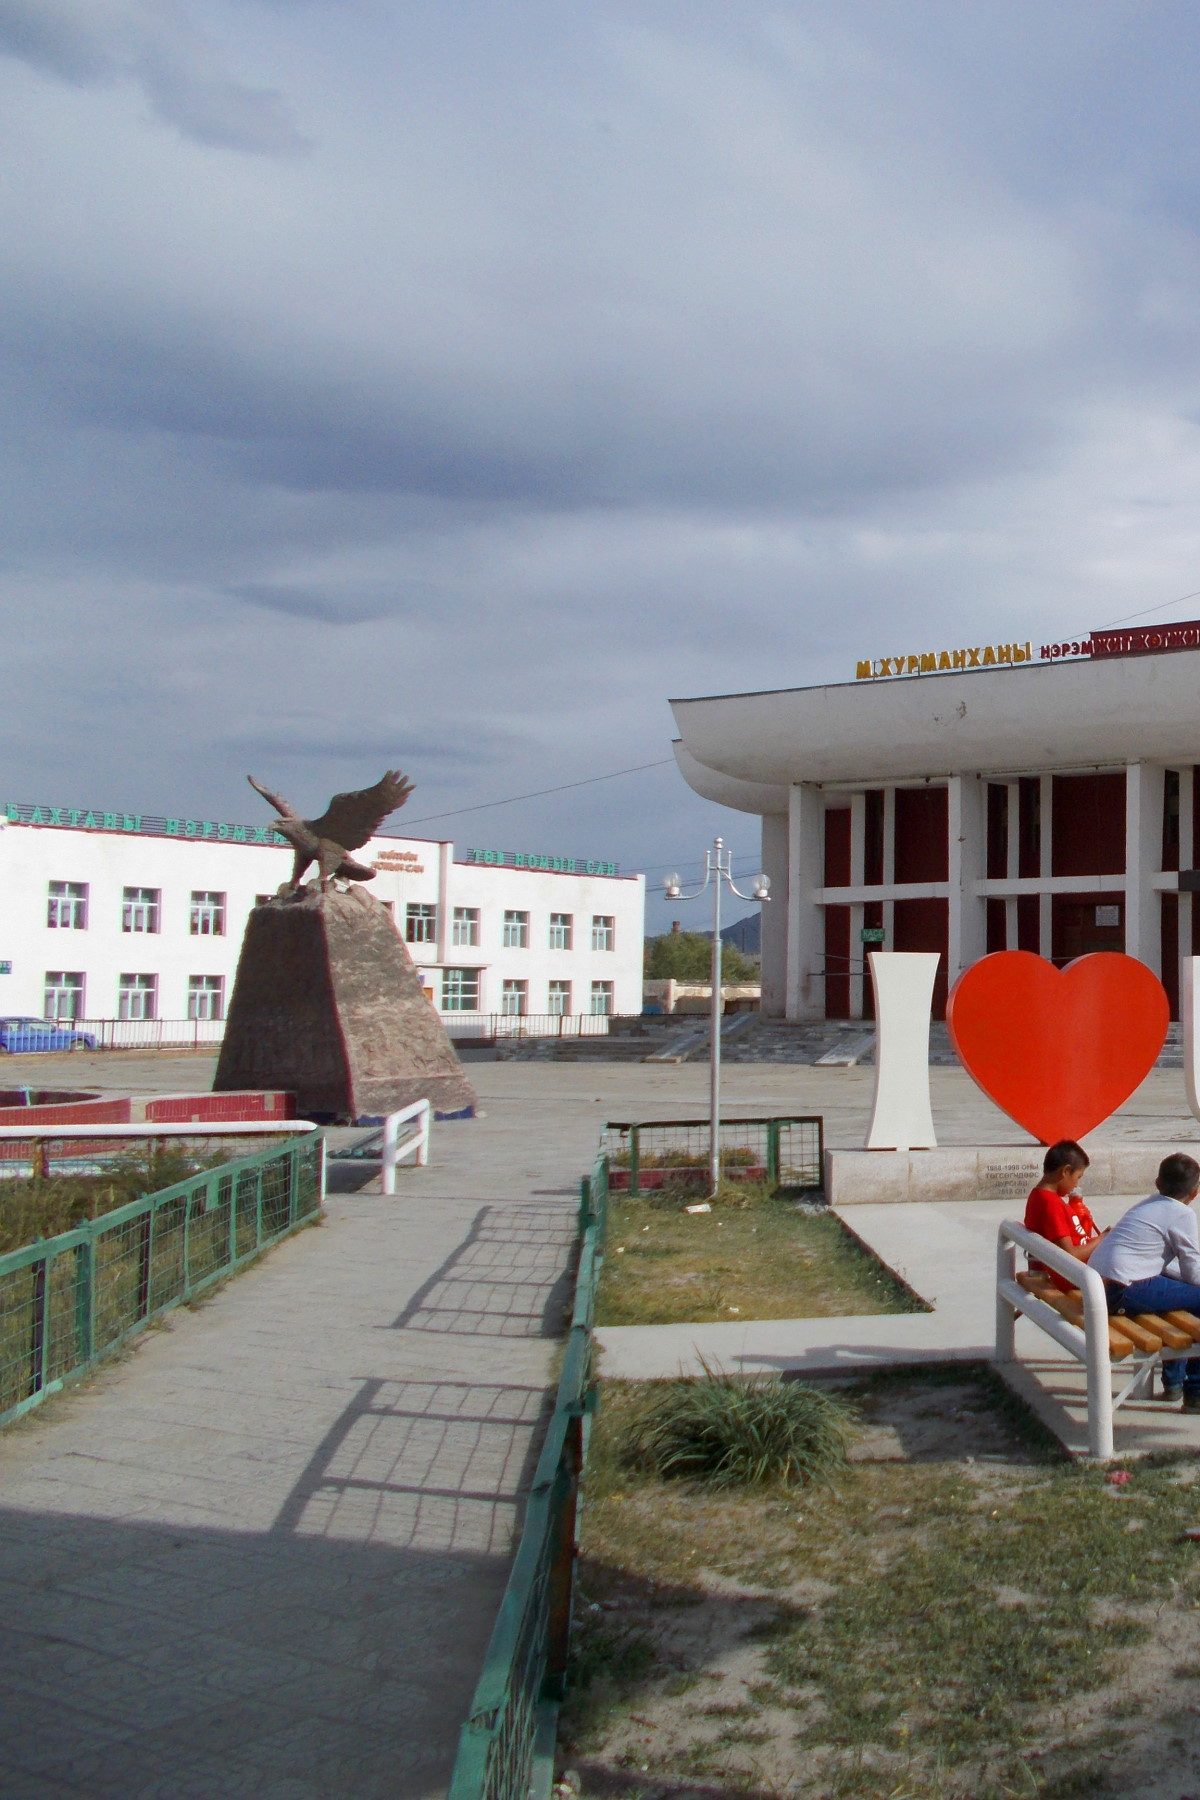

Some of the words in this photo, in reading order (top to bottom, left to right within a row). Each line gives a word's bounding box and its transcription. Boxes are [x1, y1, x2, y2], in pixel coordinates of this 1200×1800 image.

[6, 803, 142, 833] Б.АХТАНЫ
[166, 818, 287, 845] НЭРЭМЖИ
[866, 951, 941, 1149] I
